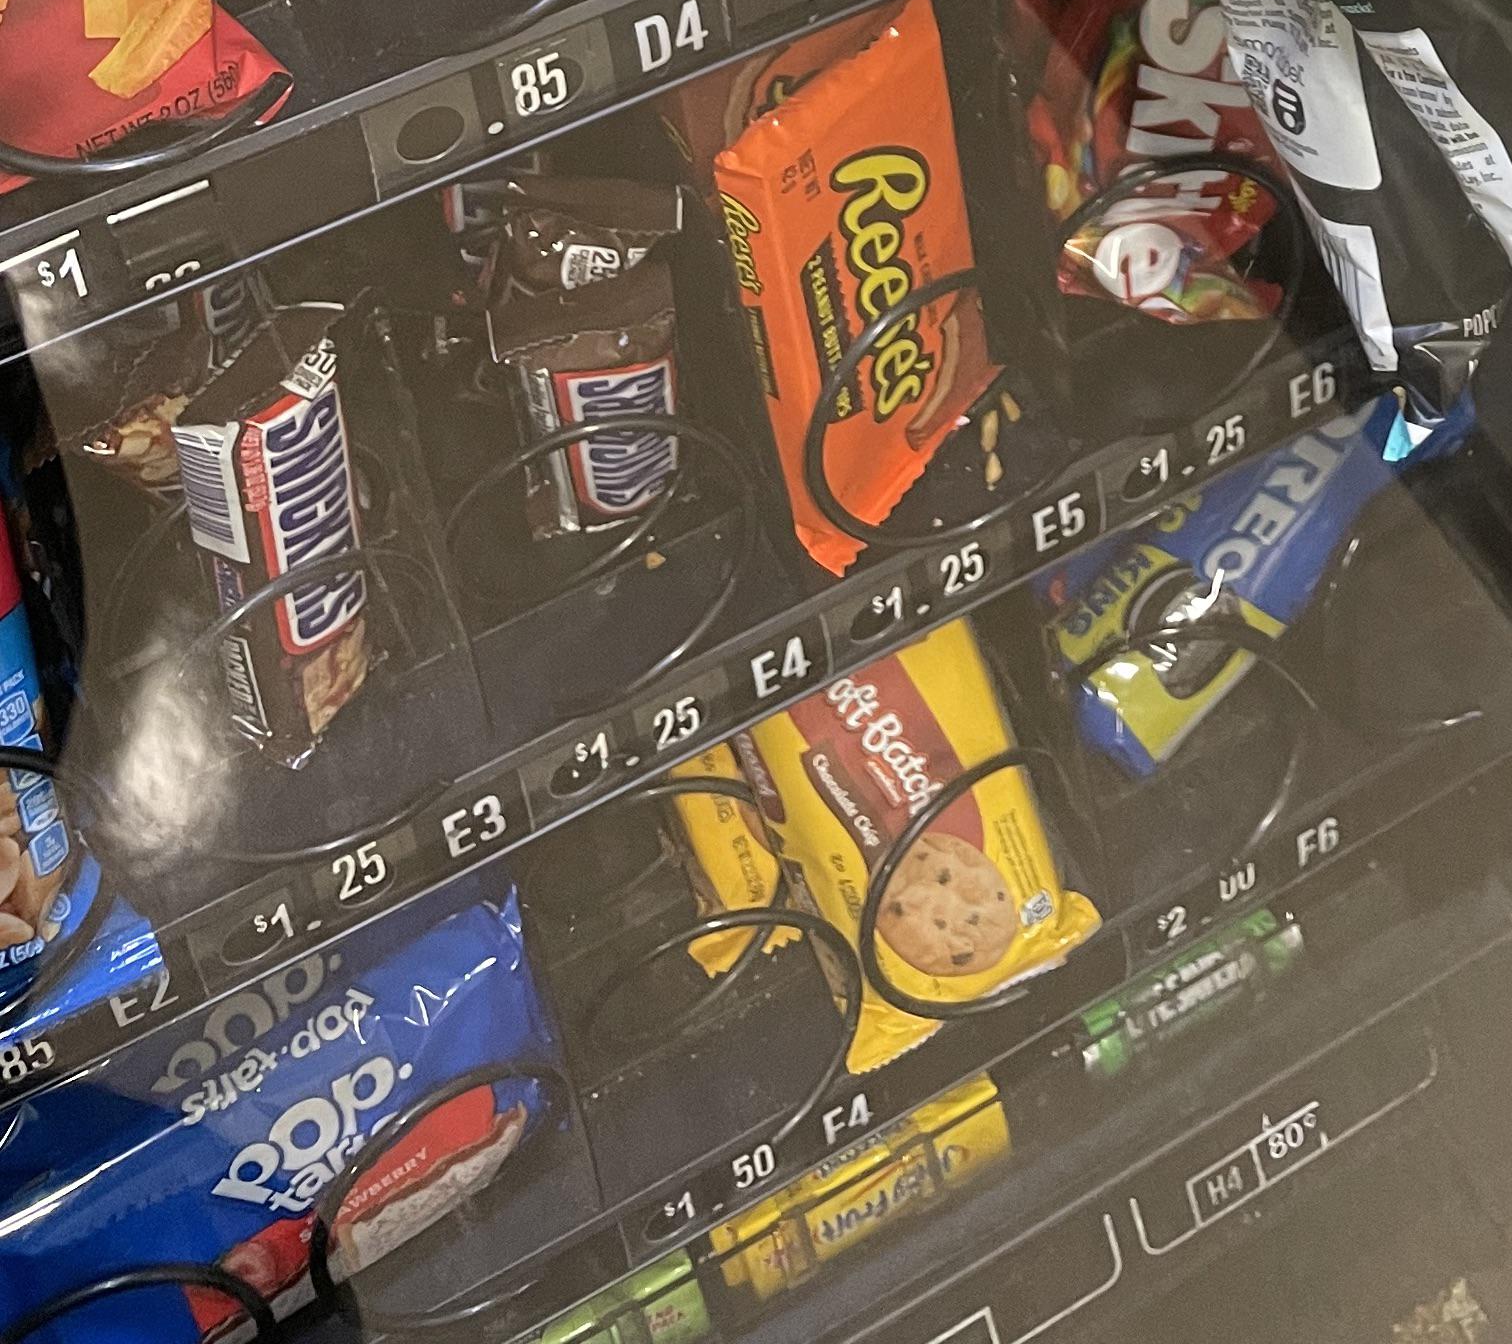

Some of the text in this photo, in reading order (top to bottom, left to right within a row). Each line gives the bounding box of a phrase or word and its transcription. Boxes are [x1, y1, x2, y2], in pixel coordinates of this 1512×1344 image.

[38, 246, 89, 298] $1
[1288, 361, 1336, 419] E6
[1032, 491, 1087, 553] E5
[749, 635, 812, 700] E4
[827, 677, 879, 730] oft
[440, 793, 508, 860] E3
[1295, 816, 1340, 867] F6
[0, 1032, 56, 1084] 85
[821, 1092, 876, 1147] F4
[1206, 1168, 1245, 1207] H4
